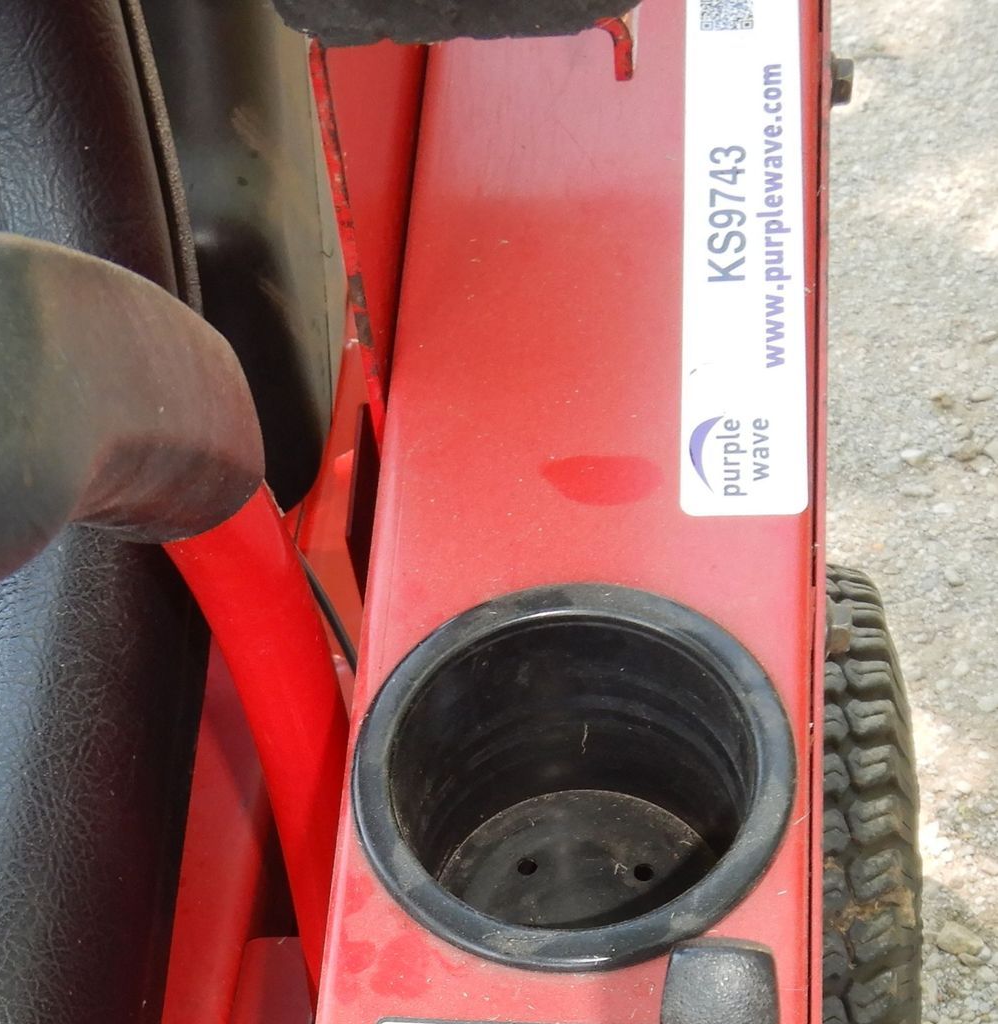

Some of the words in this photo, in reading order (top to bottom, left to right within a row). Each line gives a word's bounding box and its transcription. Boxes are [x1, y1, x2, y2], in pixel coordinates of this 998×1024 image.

[706, 144, 747, 283] KS9743
[756, 62, 791, 369] www.purplewave.com
[715, 418, 747, 497] purple
[752, 417, 770, 482] wave
